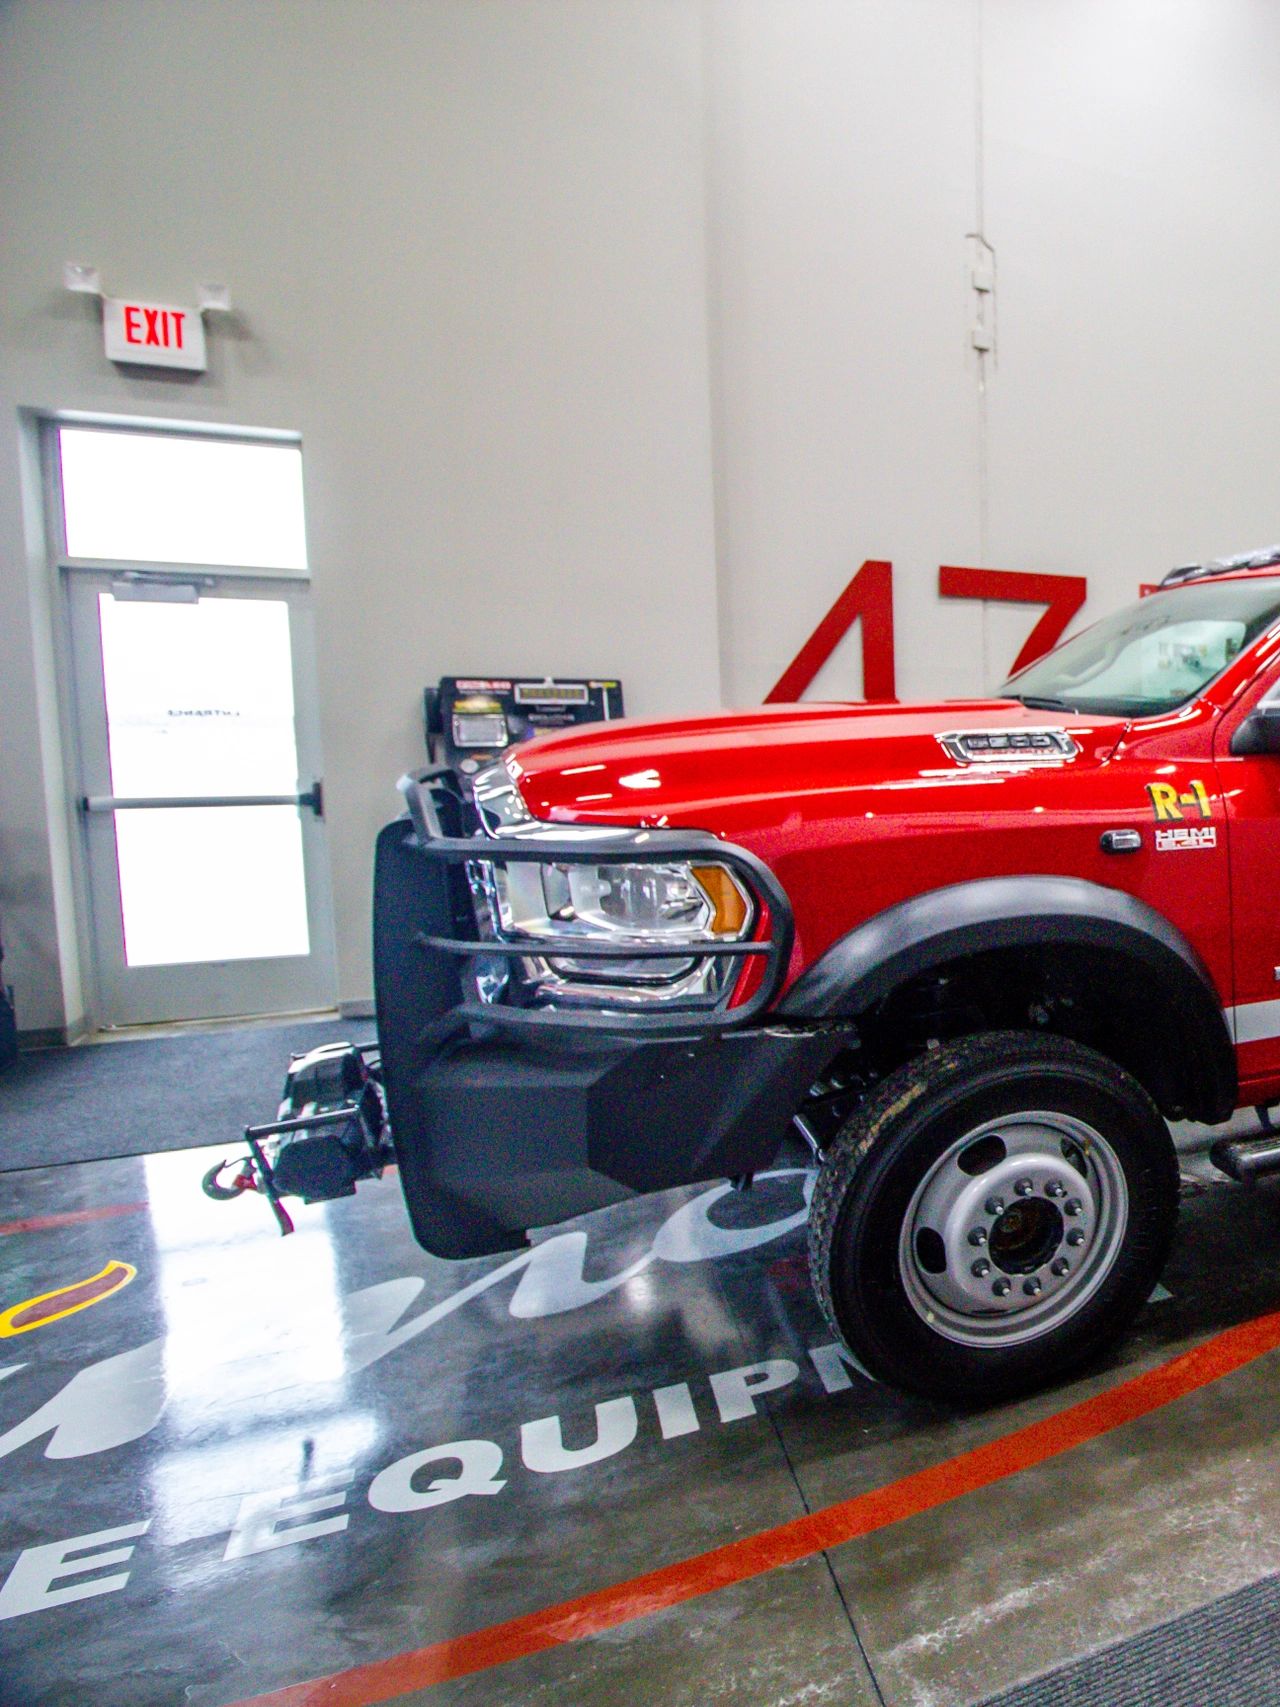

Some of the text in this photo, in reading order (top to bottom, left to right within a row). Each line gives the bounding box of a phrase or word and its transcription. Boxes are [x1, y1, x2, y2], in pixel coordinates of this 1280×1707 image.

[124, 305, 185, 349] EXIT
[1145, 779, 1212, 822] R-1
[1155, 826, 1217, 839] HEMI
